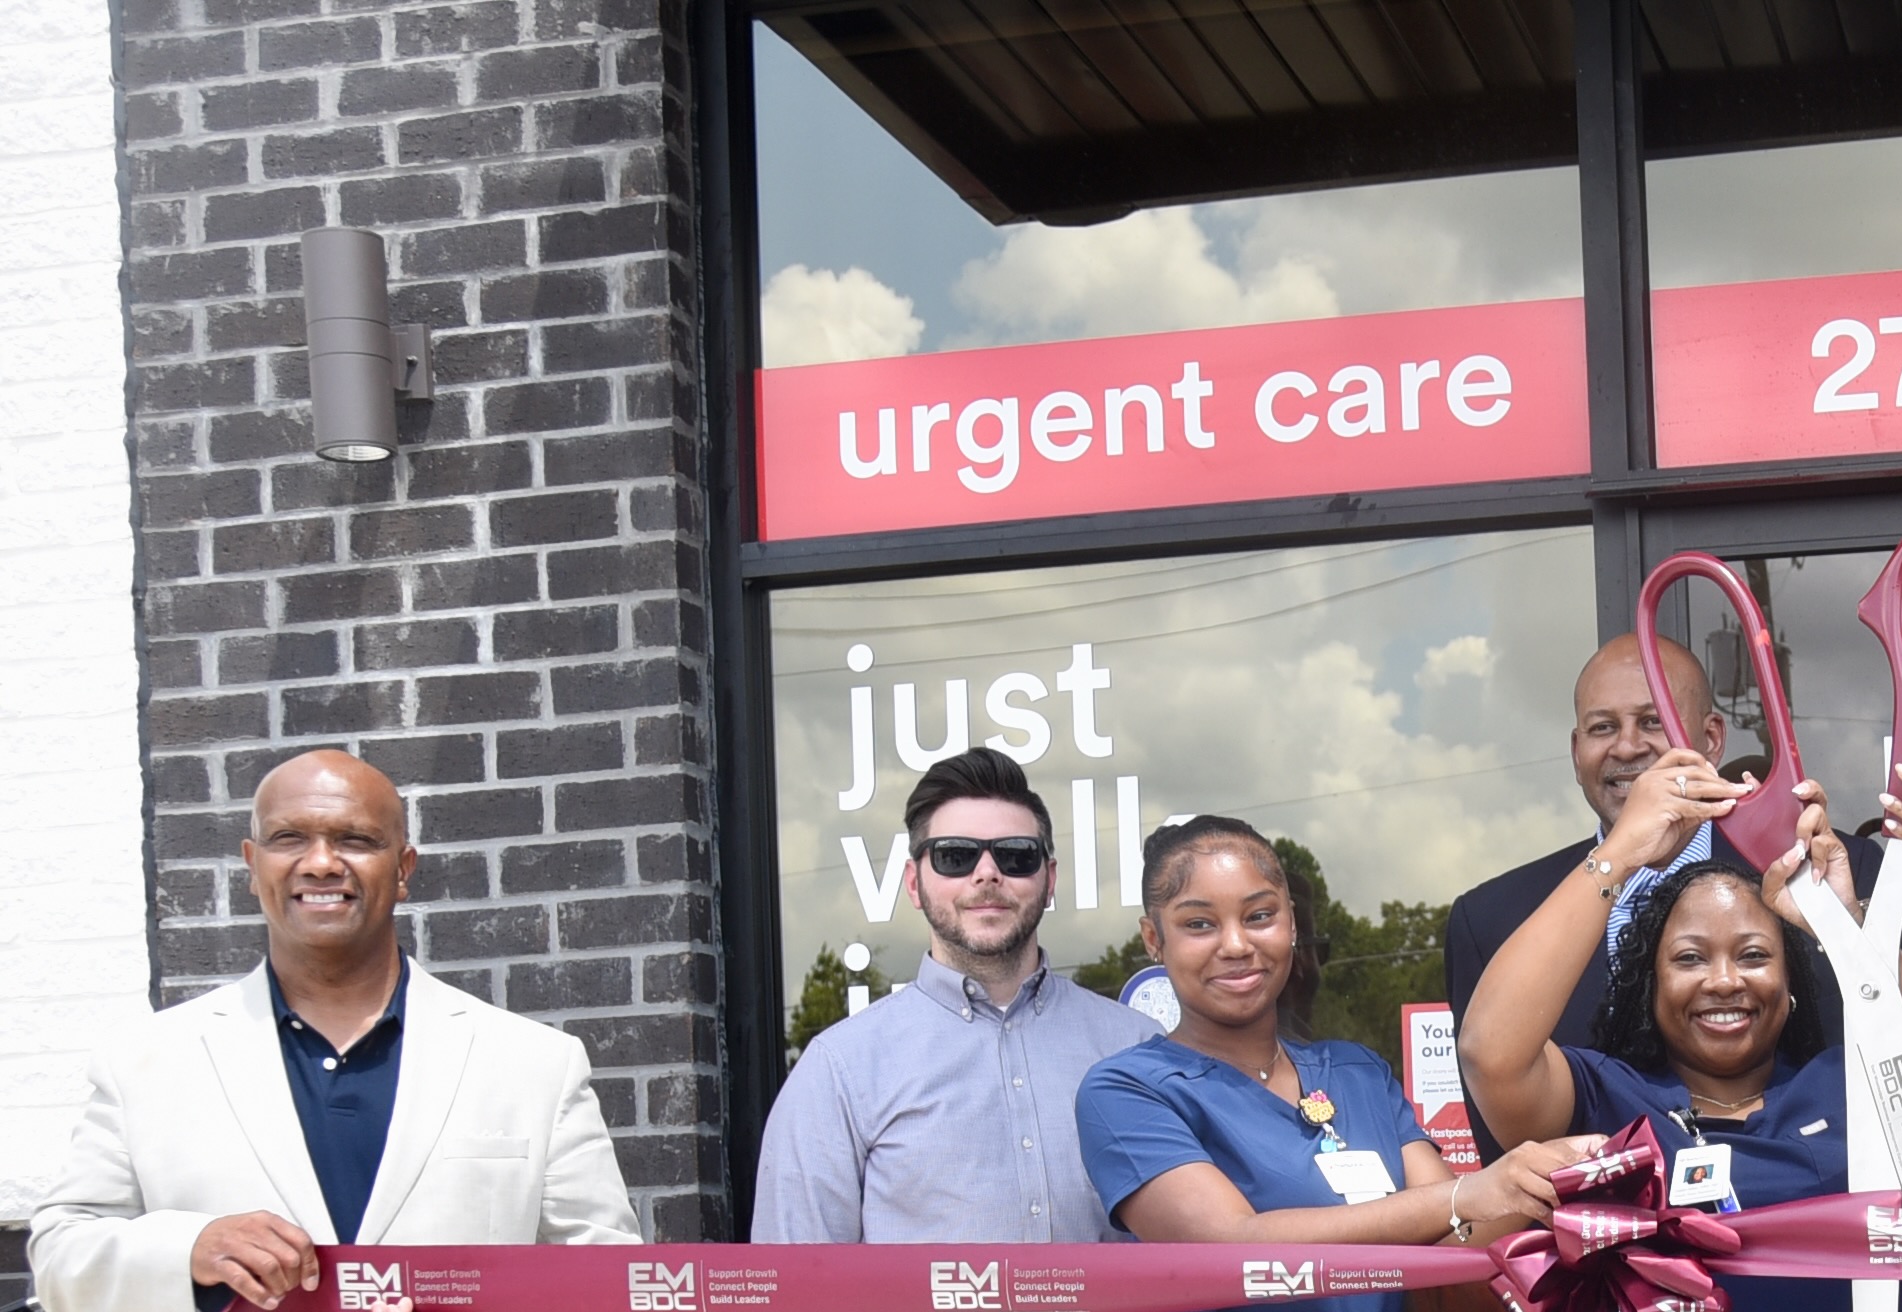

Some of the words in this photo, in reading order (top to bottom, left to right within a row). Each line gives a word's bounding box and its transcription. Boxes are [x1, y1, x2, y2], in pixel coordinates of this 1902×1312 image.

[839, 361, 1216, 494] urgent
[1254, 354, 1513, 443] care
[838, 643, 1114, 811] just
[1422, 1046, 1452, 1057] our
[336, 1262, 402, 1291] EM
[414, 1269, 448, 1279] Support
[449, 1269, 480, 1278] Growth
[628, 1262, 694, 1291] EM
[708, 1269, 743, 1279] Support
[745, 1269, 777, 1278] Growth
[930, 1261, 999, 1291] EM
[1013, 1268, 1050, 1279] Support
[1052, 1268, 1085, 1277] Growth
[1243, 1261, 1314, 1290] EM
[1329, 1268, 1366, 1279] Support
[1368, 1268, 1403, 1278] Growth
[414, 1282, 449, 1291] Connect
[451, 1282, 480, 1292] People
[708, 1282, 745, 1291] Connect
[748, 1282, 778, 1292] People
[1013, 1281, 1051, 1291] Connect
[1054, 1281, 1085, 1292] People
[1329, 1281, 1369, 1289] Connect
[415, 1295, 436, 1304] Build
[438, 1296, 473, 1304] Leaders
[629, 1292, 697, 1311] BDC
[710, 1295, 733, 1304] Build
[734, 1295, 770, 1304] Leaders
[932, 1291, 1002, 1310] BDC
[1014, 1294, 1039, 1303] Build
[1041, 1294, 1077, 1303] Leaders
